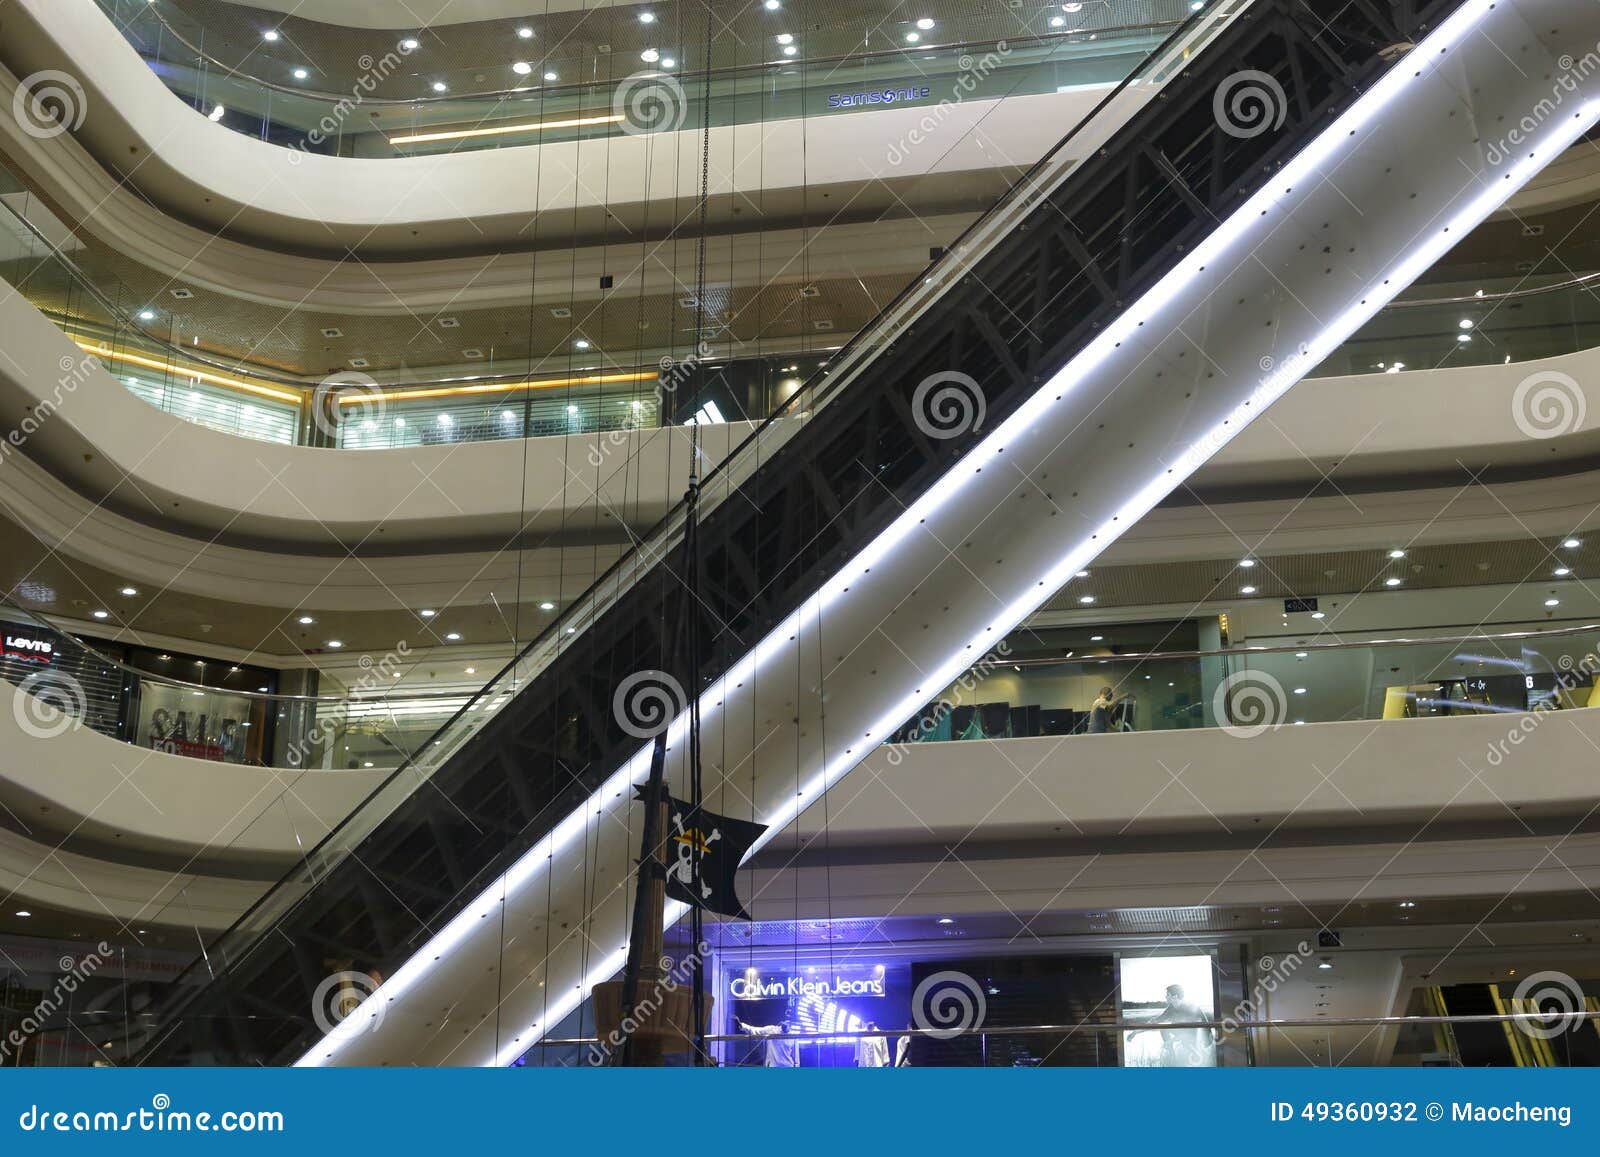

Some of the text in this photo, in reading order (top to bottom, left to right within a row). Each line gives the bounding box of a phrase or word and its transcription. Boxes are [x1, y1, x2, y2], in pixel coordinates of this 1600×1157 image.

[828, 86, 930, 108] Samsonite
[1525, 676, 1534, 689] 6
[731, 976, 882, 997] Calvin Klein Jeans
